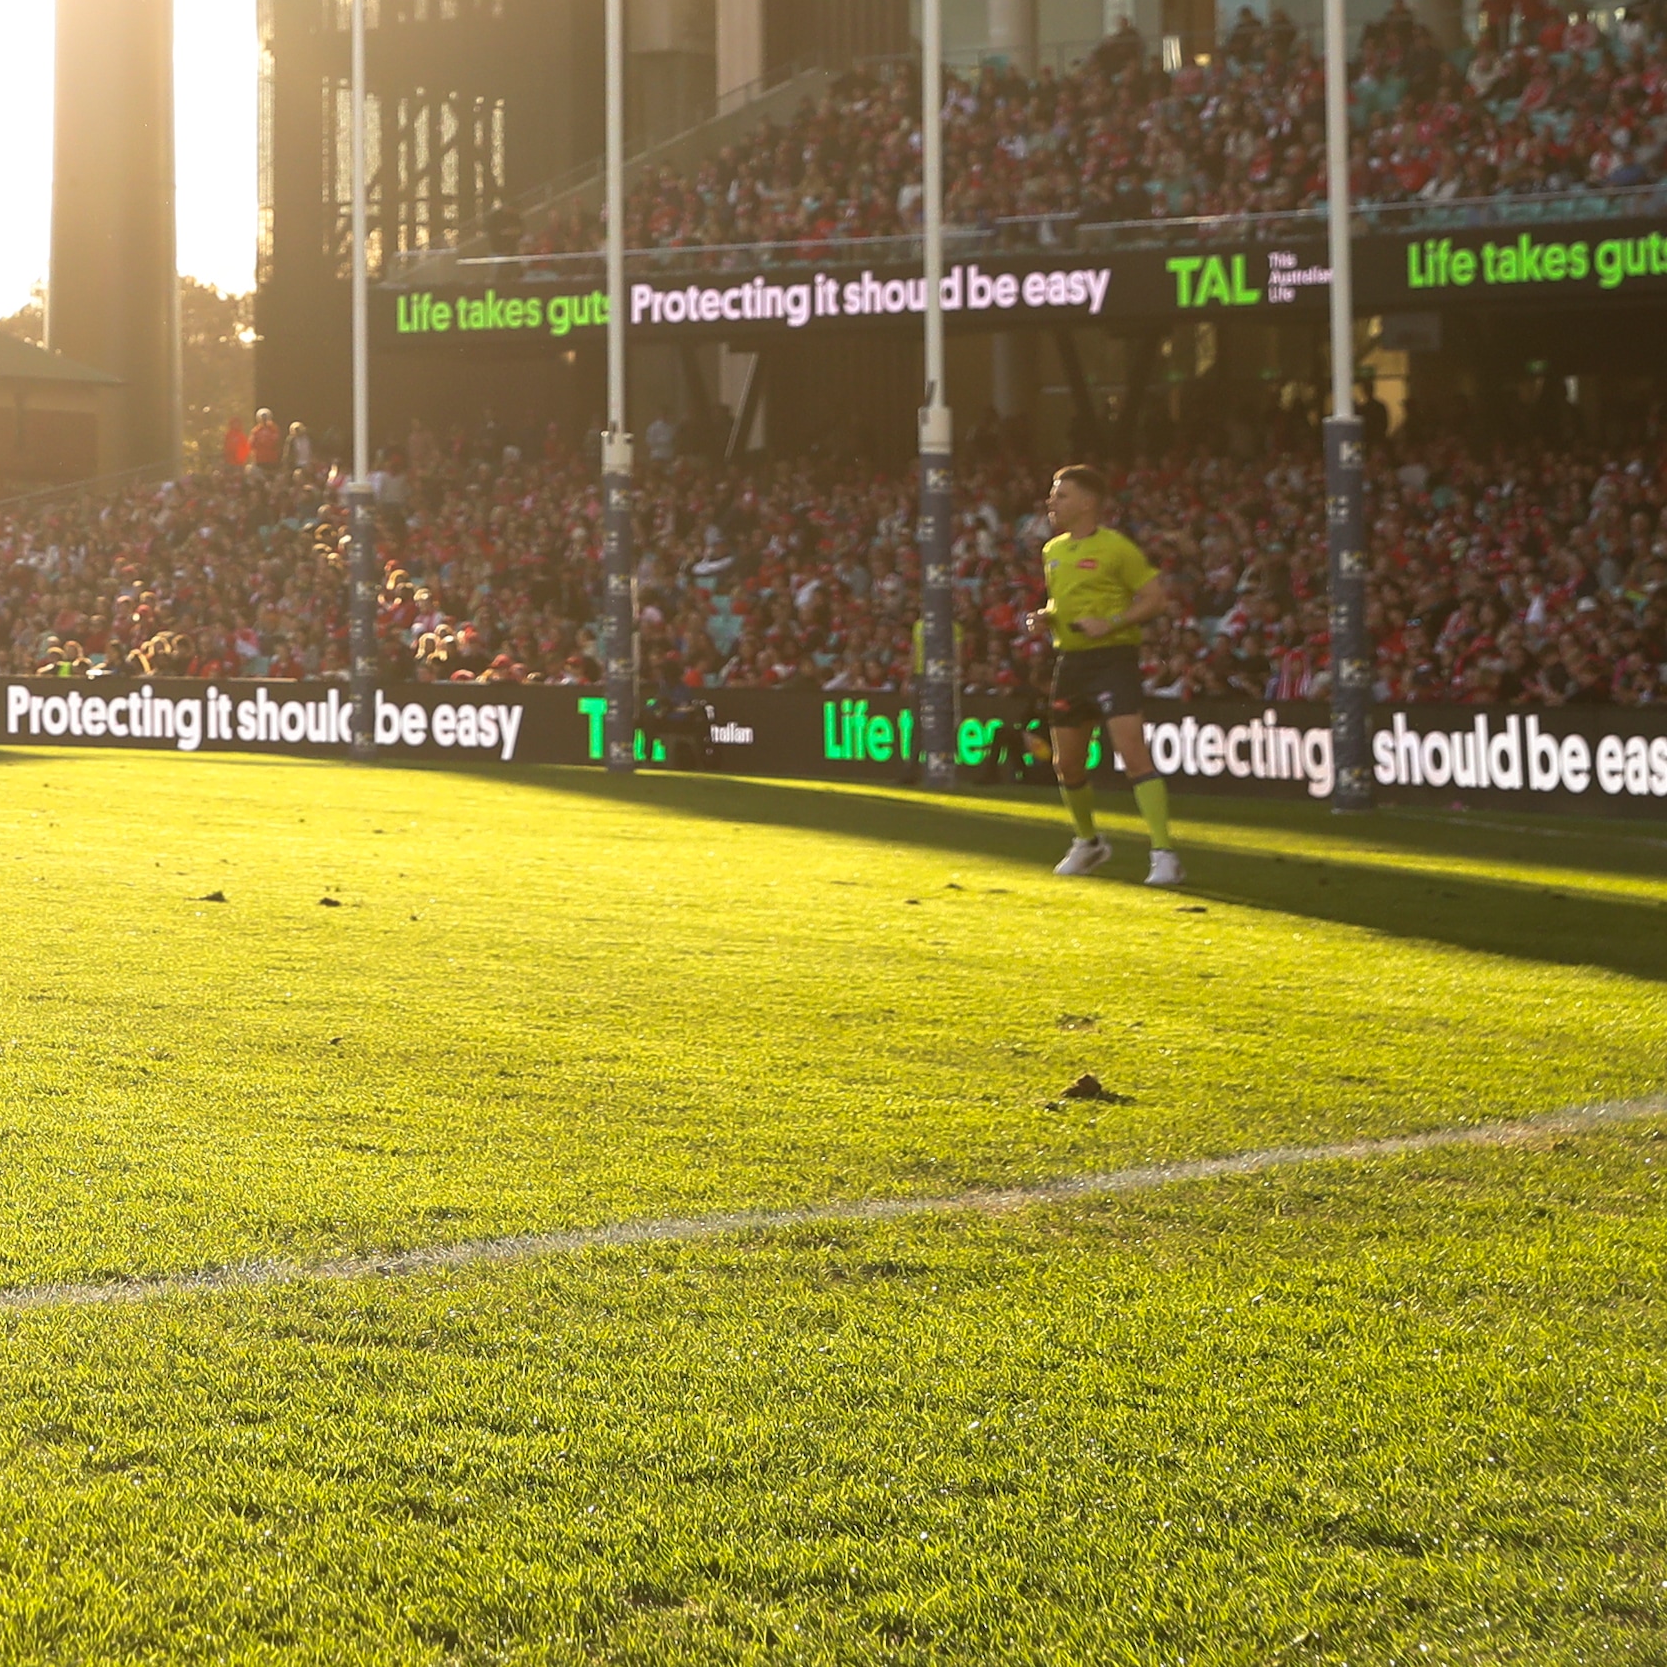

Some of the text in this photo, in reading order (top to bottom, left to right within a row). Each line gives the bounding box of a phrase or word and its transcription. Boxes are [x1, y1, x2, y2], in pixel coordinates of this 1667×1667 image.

[1166, 253, 1262, 308] TAL
[1407, 238, 1477, 288] Life
[1481, 233, 1590, 284] takes
[397, 292, 453, 333] Life
[456, 288, 542, 331] takes
[630, 264, 1111, 327] Protecting it shoud be easy
[7, 684, 203, 751] Protecting
[207, 685, 233, 740] it
[373, 688, 428, 747] be
[431, 702, 524, 761] easy
[823, 698, 894, 762] Life
[1372, 712, 1524, 791] should
[1525, 713, 1591, 793] be
